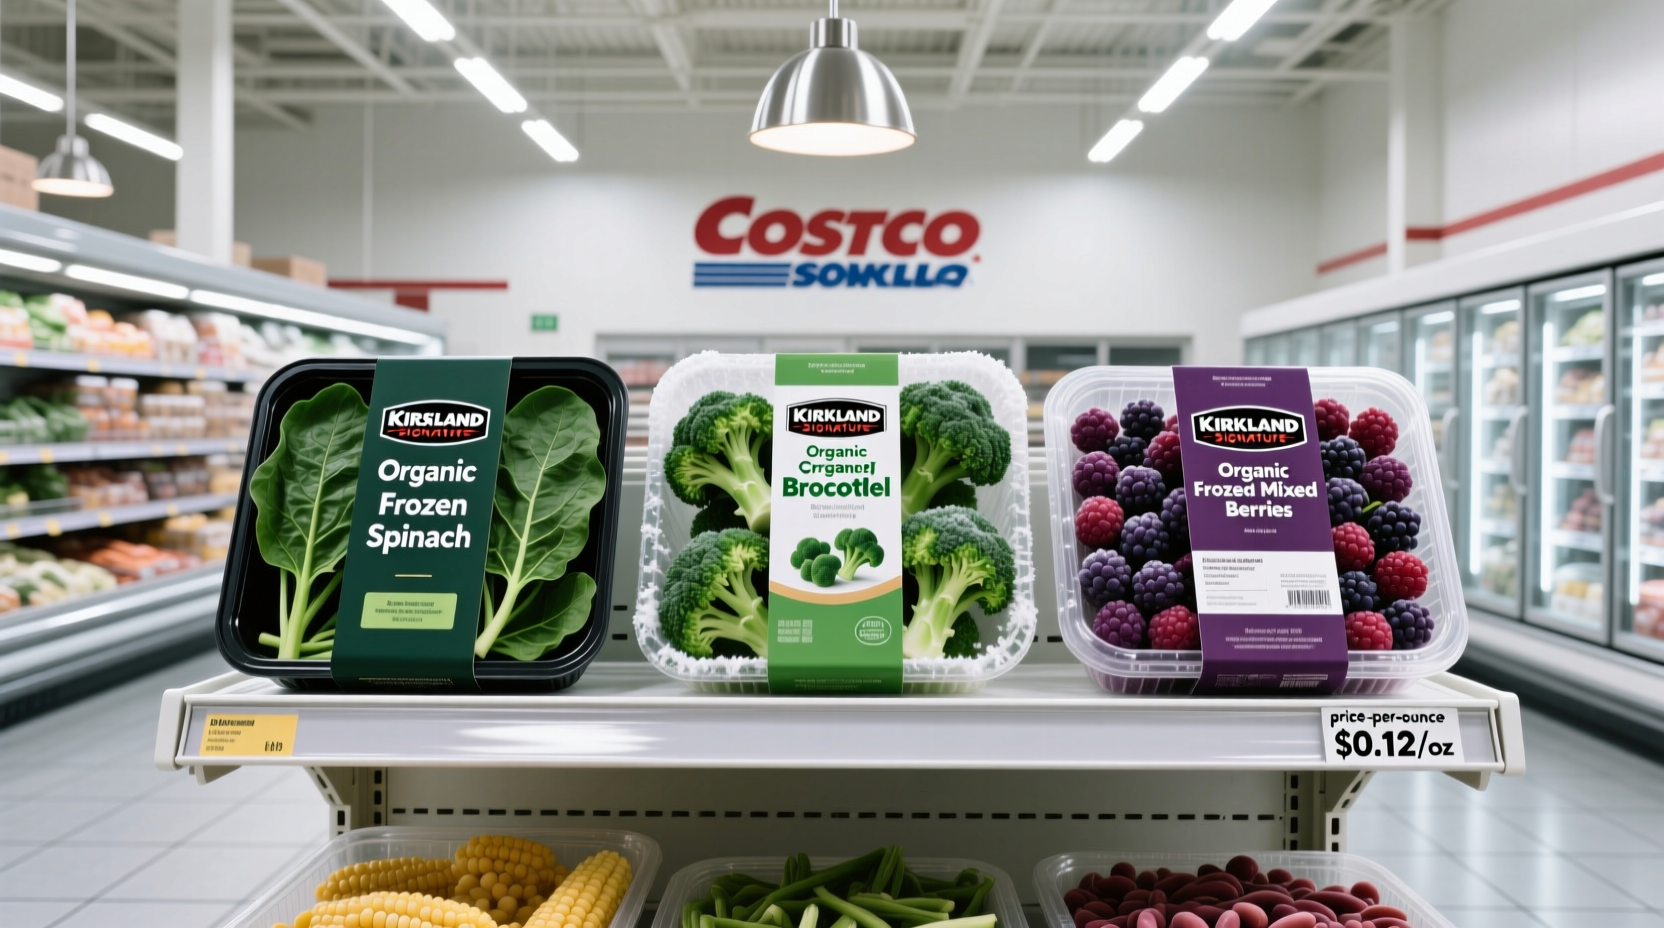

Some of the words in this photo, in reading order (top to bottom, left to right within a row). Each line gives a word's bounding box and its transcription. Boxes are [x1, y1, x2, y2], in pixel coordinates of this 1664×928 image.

[694, 195, 980, 256] COSTCO
[793, 408, 881, 423] KIRKLAND
[1199, 416, 1299, 433] KIRKLAND
[806, 445, 867, 461] Organic
[377, 458, 478, 487] Organic
[1218, 462, 1290, 482] Organic
[1193, 481, 1256, 497] Frozed
[1260, 481, 1318, 497] Mixed
[378, 492, 468, 516] Frozen
[1225, 500, 1293, 517] Berries
[366, 523, 471, 554] Spinach
[1330, 710, 1446, 728] price-per-ounce
[1335, 728, 1455, 760] $0.12/oz
